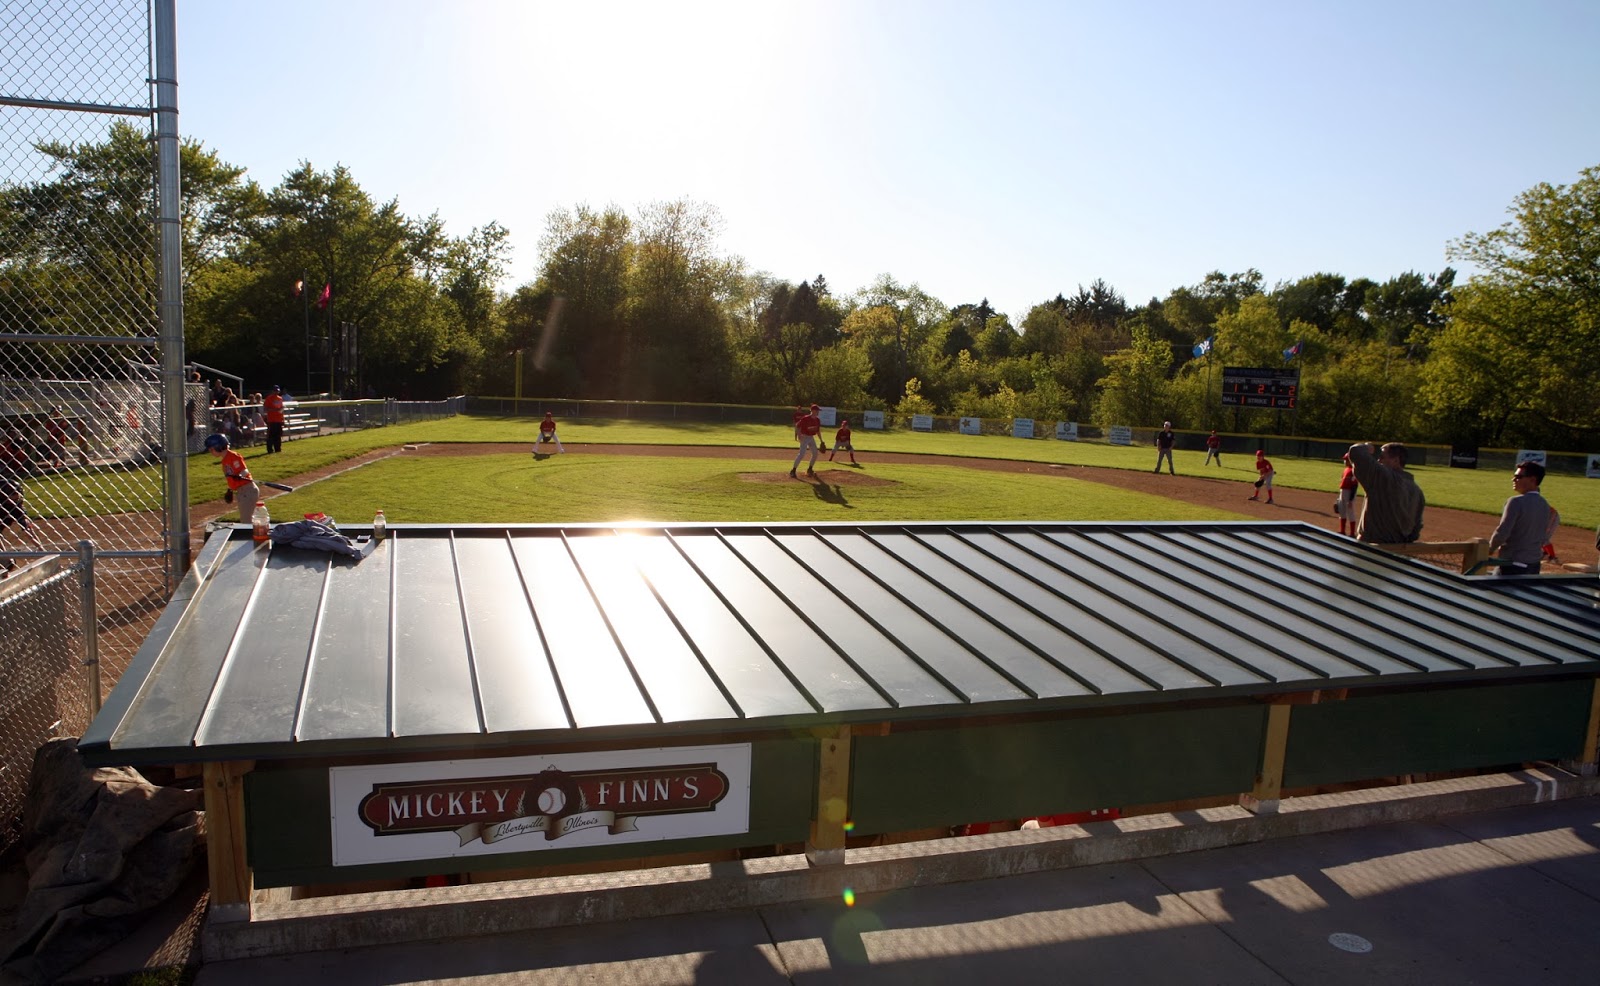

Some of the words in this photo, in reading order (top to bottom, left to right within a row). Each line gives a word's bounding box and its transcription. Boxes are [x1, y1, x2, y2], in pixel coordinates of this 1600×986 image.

[387, 788, 510, 827] MICKEY
[598, 776, 699, 805] FINN'S
[493, 816, 545, 838] Libertyville
[563, 816, 599, 832] Illinois
